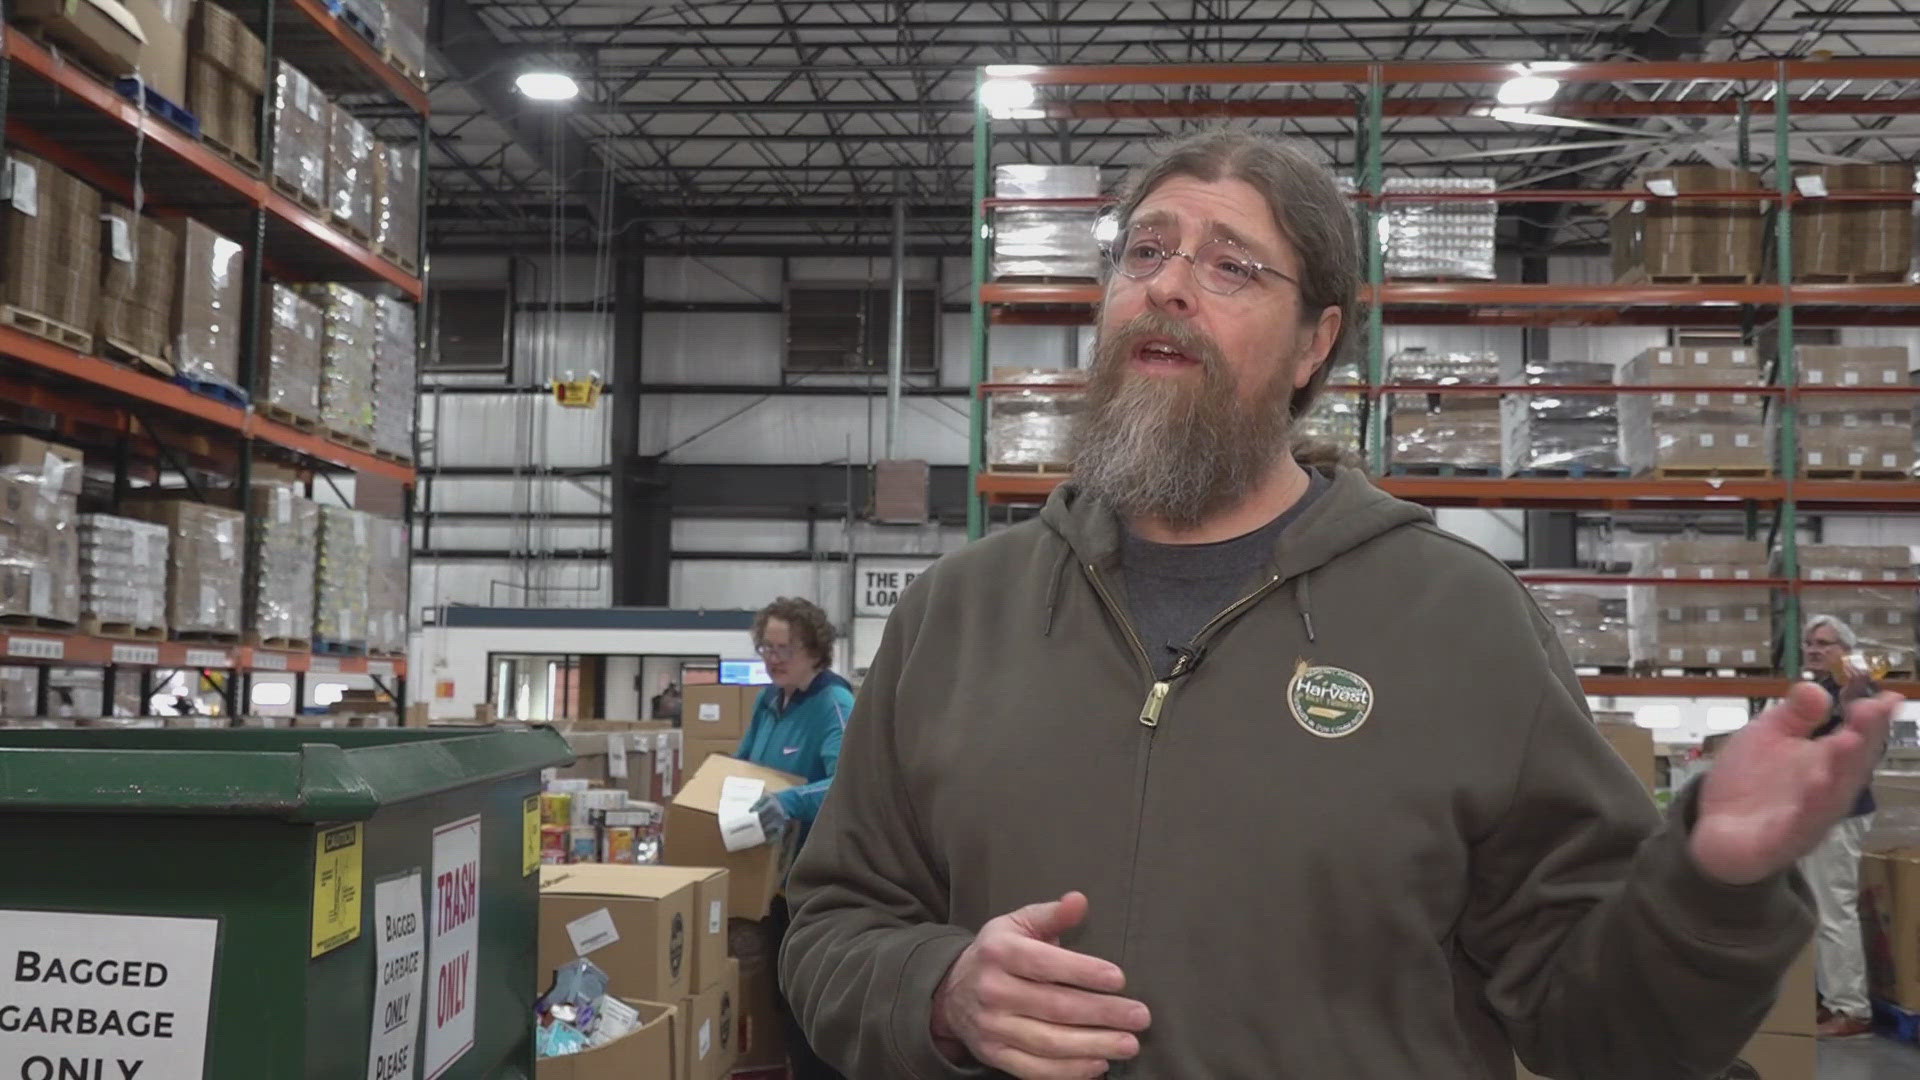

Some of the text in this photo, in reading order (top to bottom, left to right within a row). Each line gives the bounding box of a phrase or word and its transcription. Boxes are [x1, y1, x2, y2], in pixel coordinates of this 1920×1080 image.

[866, 572, 898, 588] THE
[866, 591, 898, 607] LOA
[1296, 678, 1368, 705] Harvest
[437, 861, 477, 937] TRASH
[386, 913, 417, 942] BAGGED
[15, 950, 169, 988] BAGGED
[384, 951, 419, 986] GARBAGE
[437, 950, 470, 1029] ONLY
[0, 1005, 175, 1039] GARBAGE
[385, 992, 411, 1029] ONLY
[21, 1055, 144, 1080] ONLY
[376, 1044, 409, 1080] PLEASE
